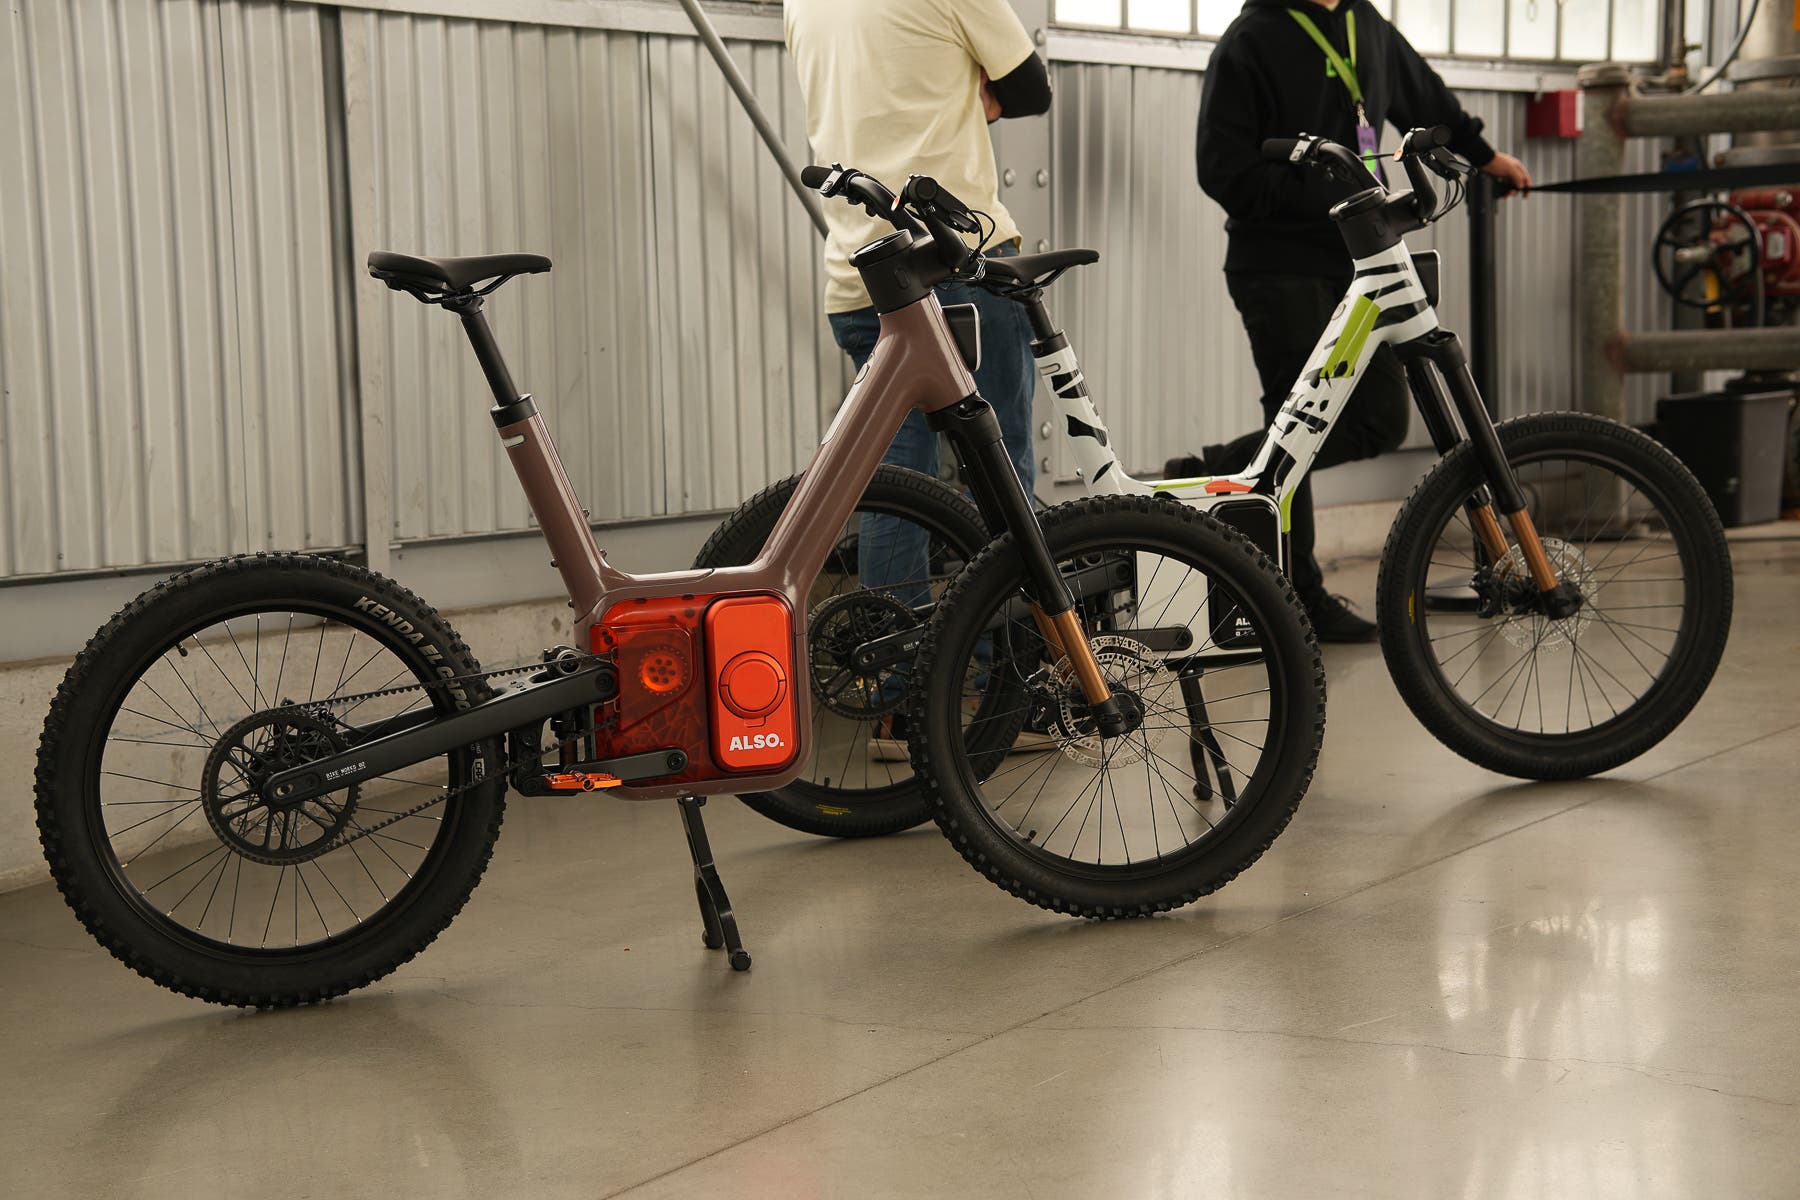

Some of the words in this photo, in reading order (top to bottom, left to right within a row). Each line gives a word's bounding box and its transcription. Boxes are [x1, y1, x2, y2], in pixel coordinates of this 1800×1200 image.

[353, 596, 424, 645] KENDA
[419, 644, 443, 664] EL
[729, 733, 785, 751] ALSO.
